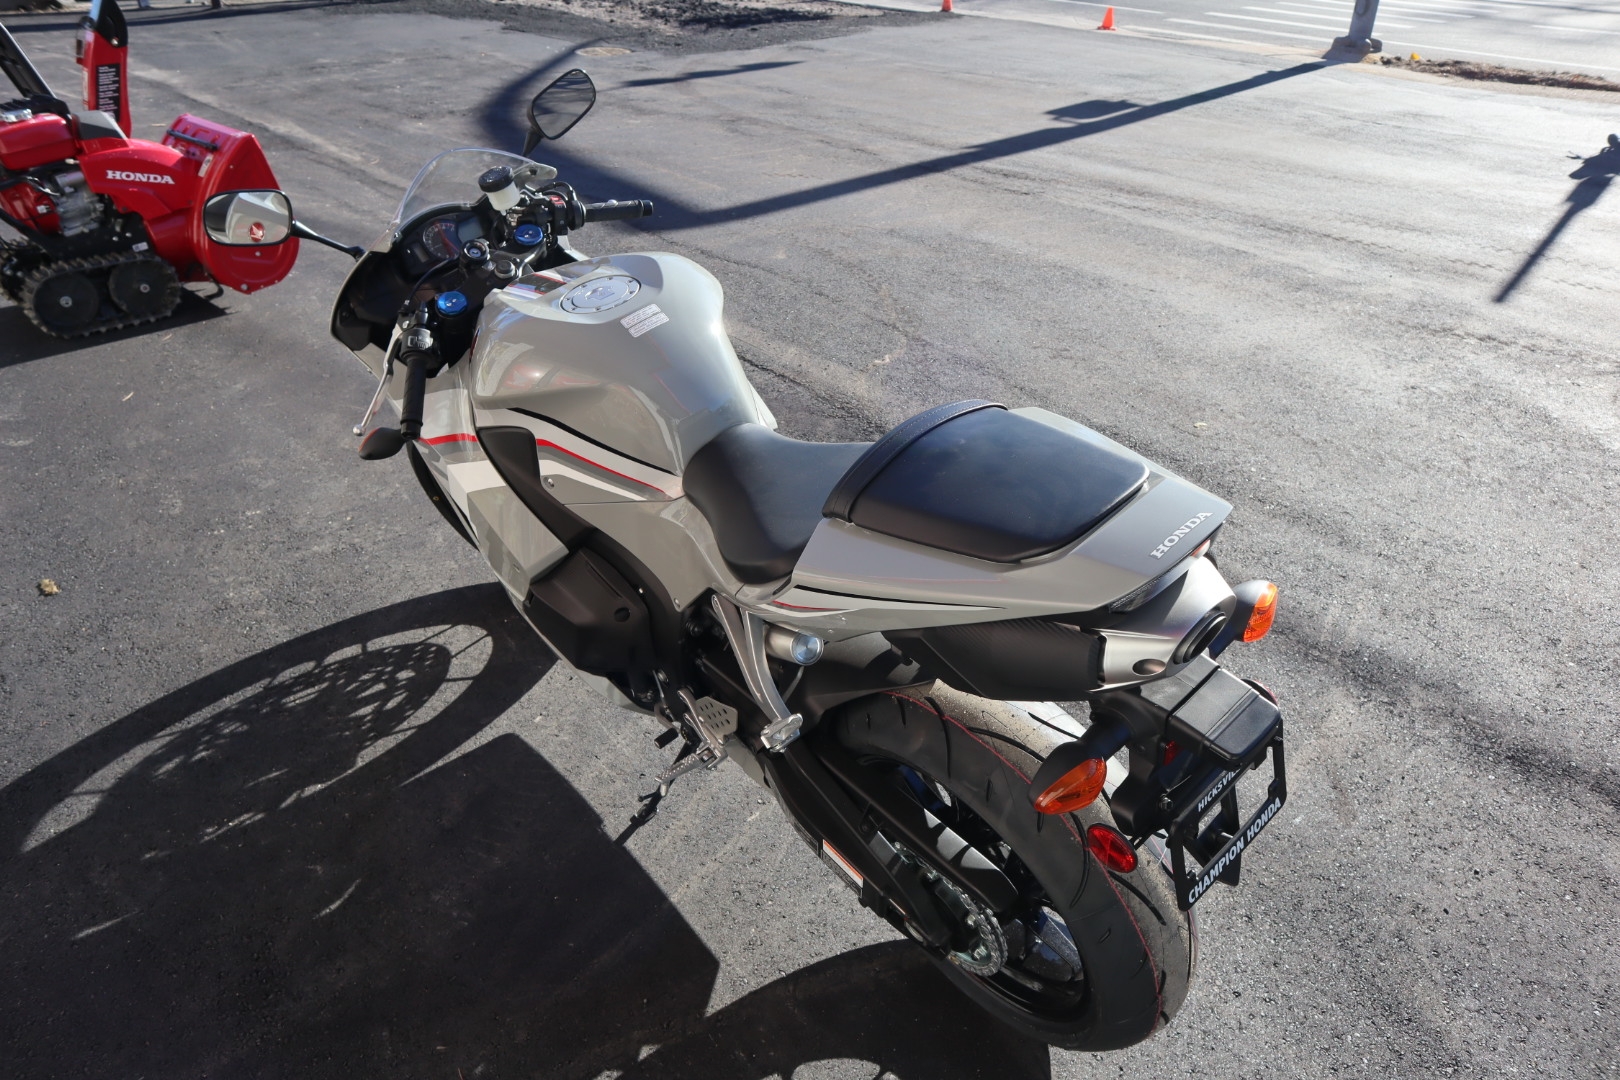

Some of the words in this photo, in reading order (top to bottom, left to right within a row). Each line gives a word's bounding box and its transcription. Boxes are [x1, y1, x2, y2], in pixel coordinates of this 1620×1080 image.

[106, 169, 175, 185] HONDA
[1150, 512, 1213, 559] HONDA
[1188, 836, 1244, 903] CHAMPION
[1247, 797, 1282, 842] HONDA
